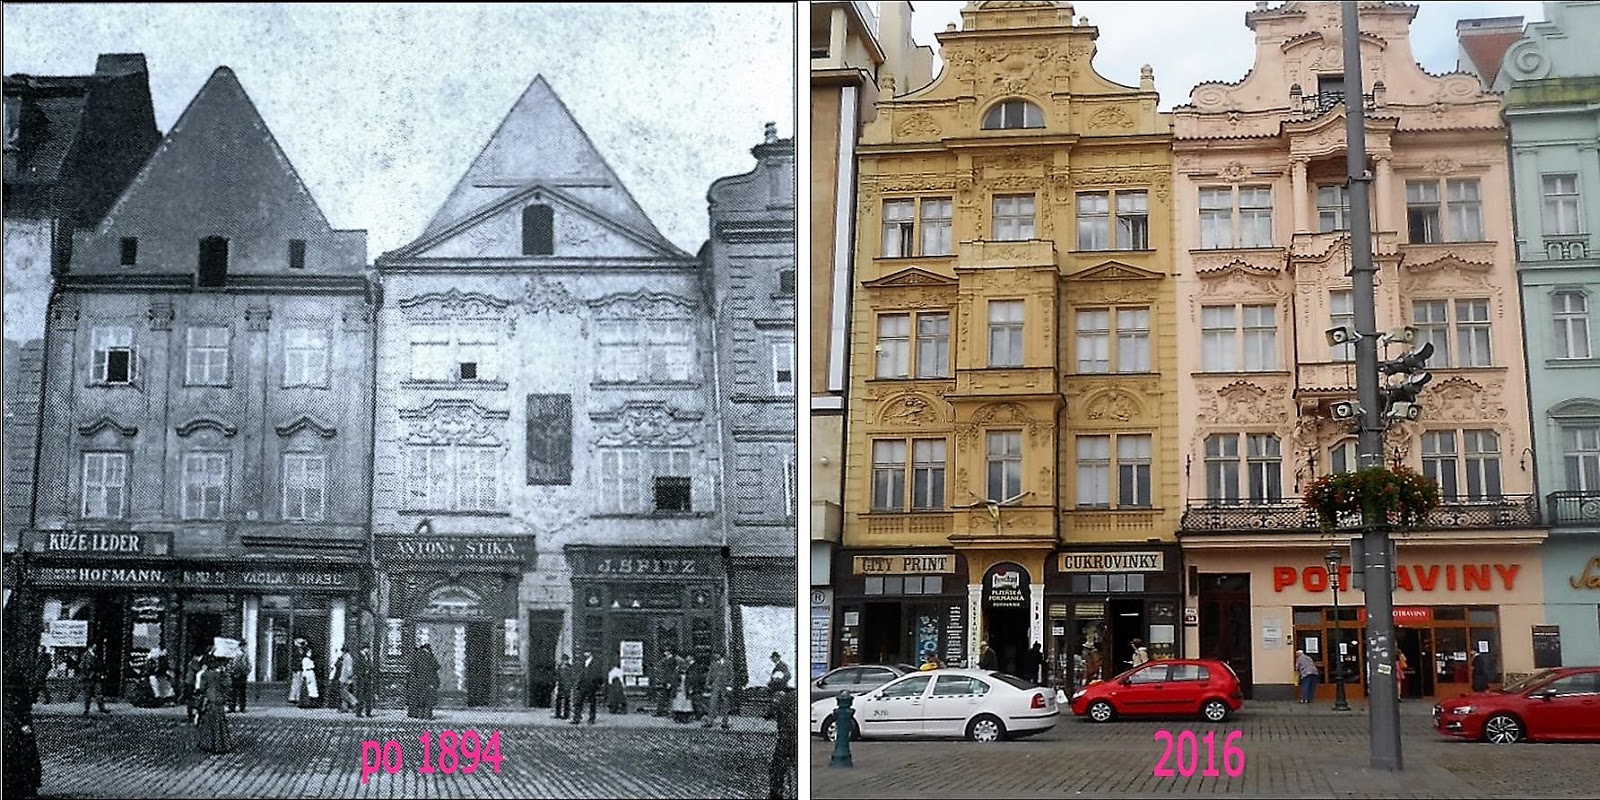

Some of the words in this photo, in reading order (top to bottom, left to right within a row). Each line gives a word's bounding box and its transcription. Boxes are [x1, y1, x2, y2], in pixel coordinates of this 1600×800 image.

[863, 558, 894, 572] CITY
[903, 557, 947, 571] PRINT
[1065, 554, 1158, 569] CUKROVINKY
[1273, 564, 1520, 592] POTAVINY
